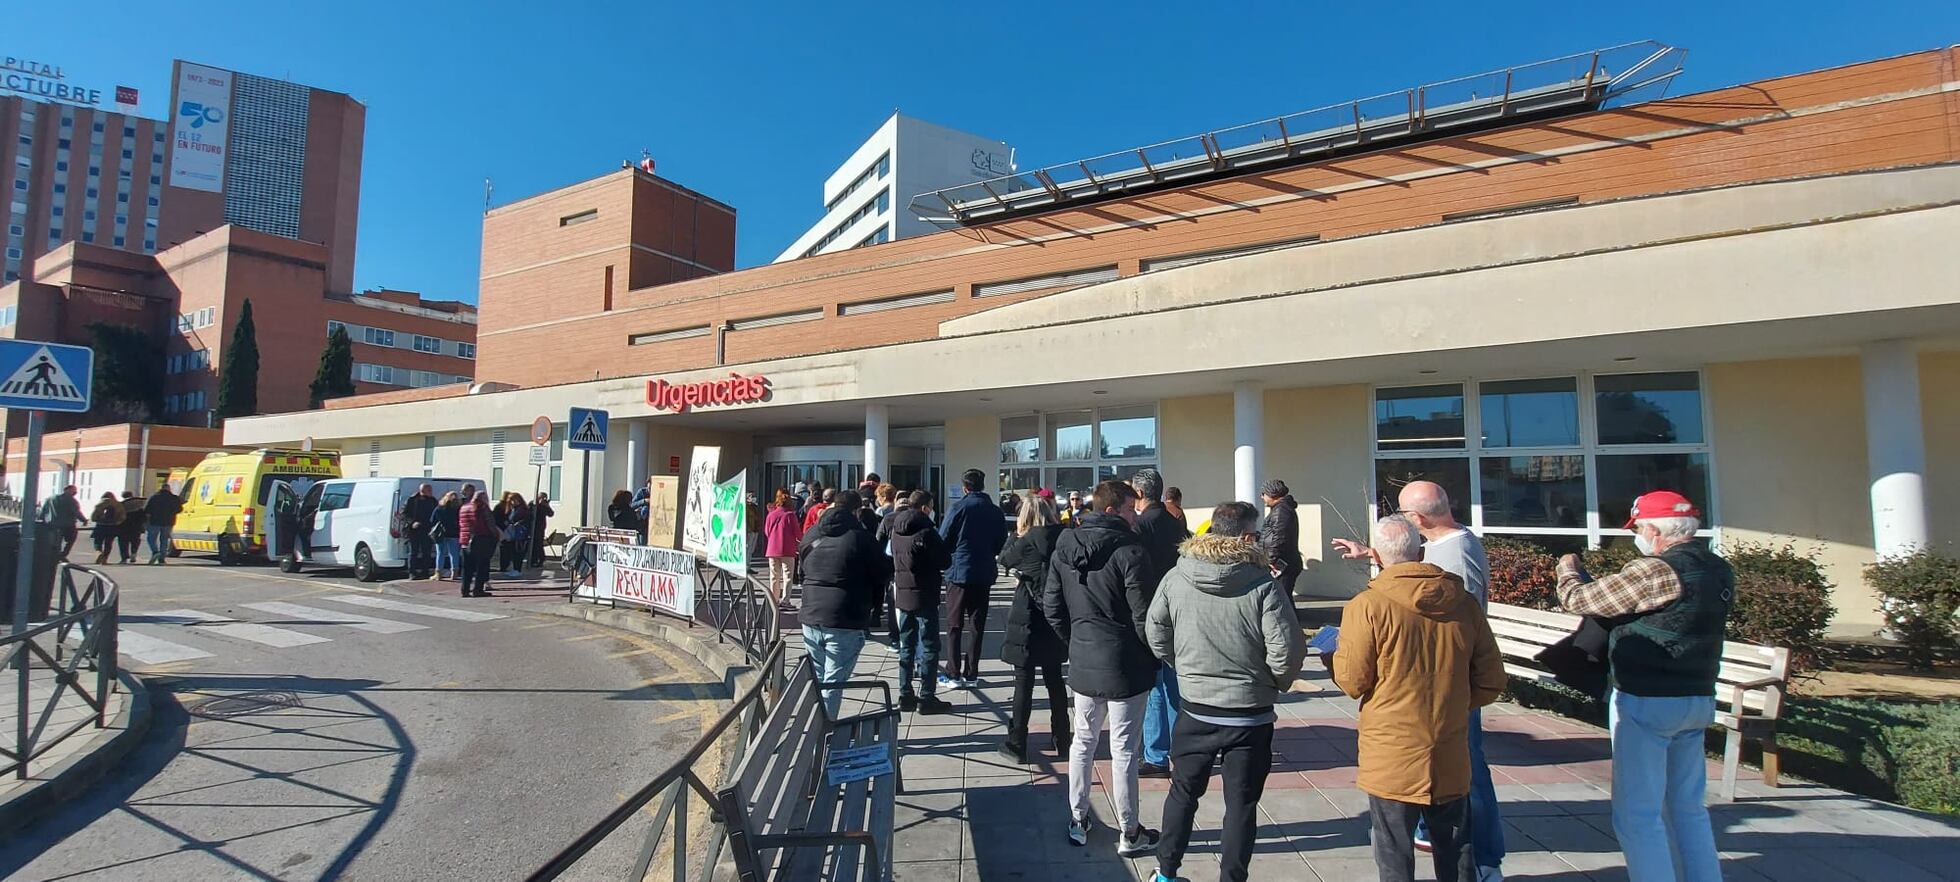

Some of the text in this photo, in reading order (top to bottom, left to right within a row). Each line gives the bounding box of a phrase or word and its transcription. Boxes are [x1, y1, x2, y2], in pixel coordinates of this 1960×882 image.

[0, 74, 101, 103] CTUBRE
[177, 140, 222, 155] EN FUTURO
[178, 131, 187, 140] EL
[646, 373, 765, 411] Urgencias
[272, 465, 332, 475] AMBULANCIA
[633, 547, 643, 568] TU
[642, 549, 670, 572] SANIDAD
[616, 568, 676, 606] RECLAMA
